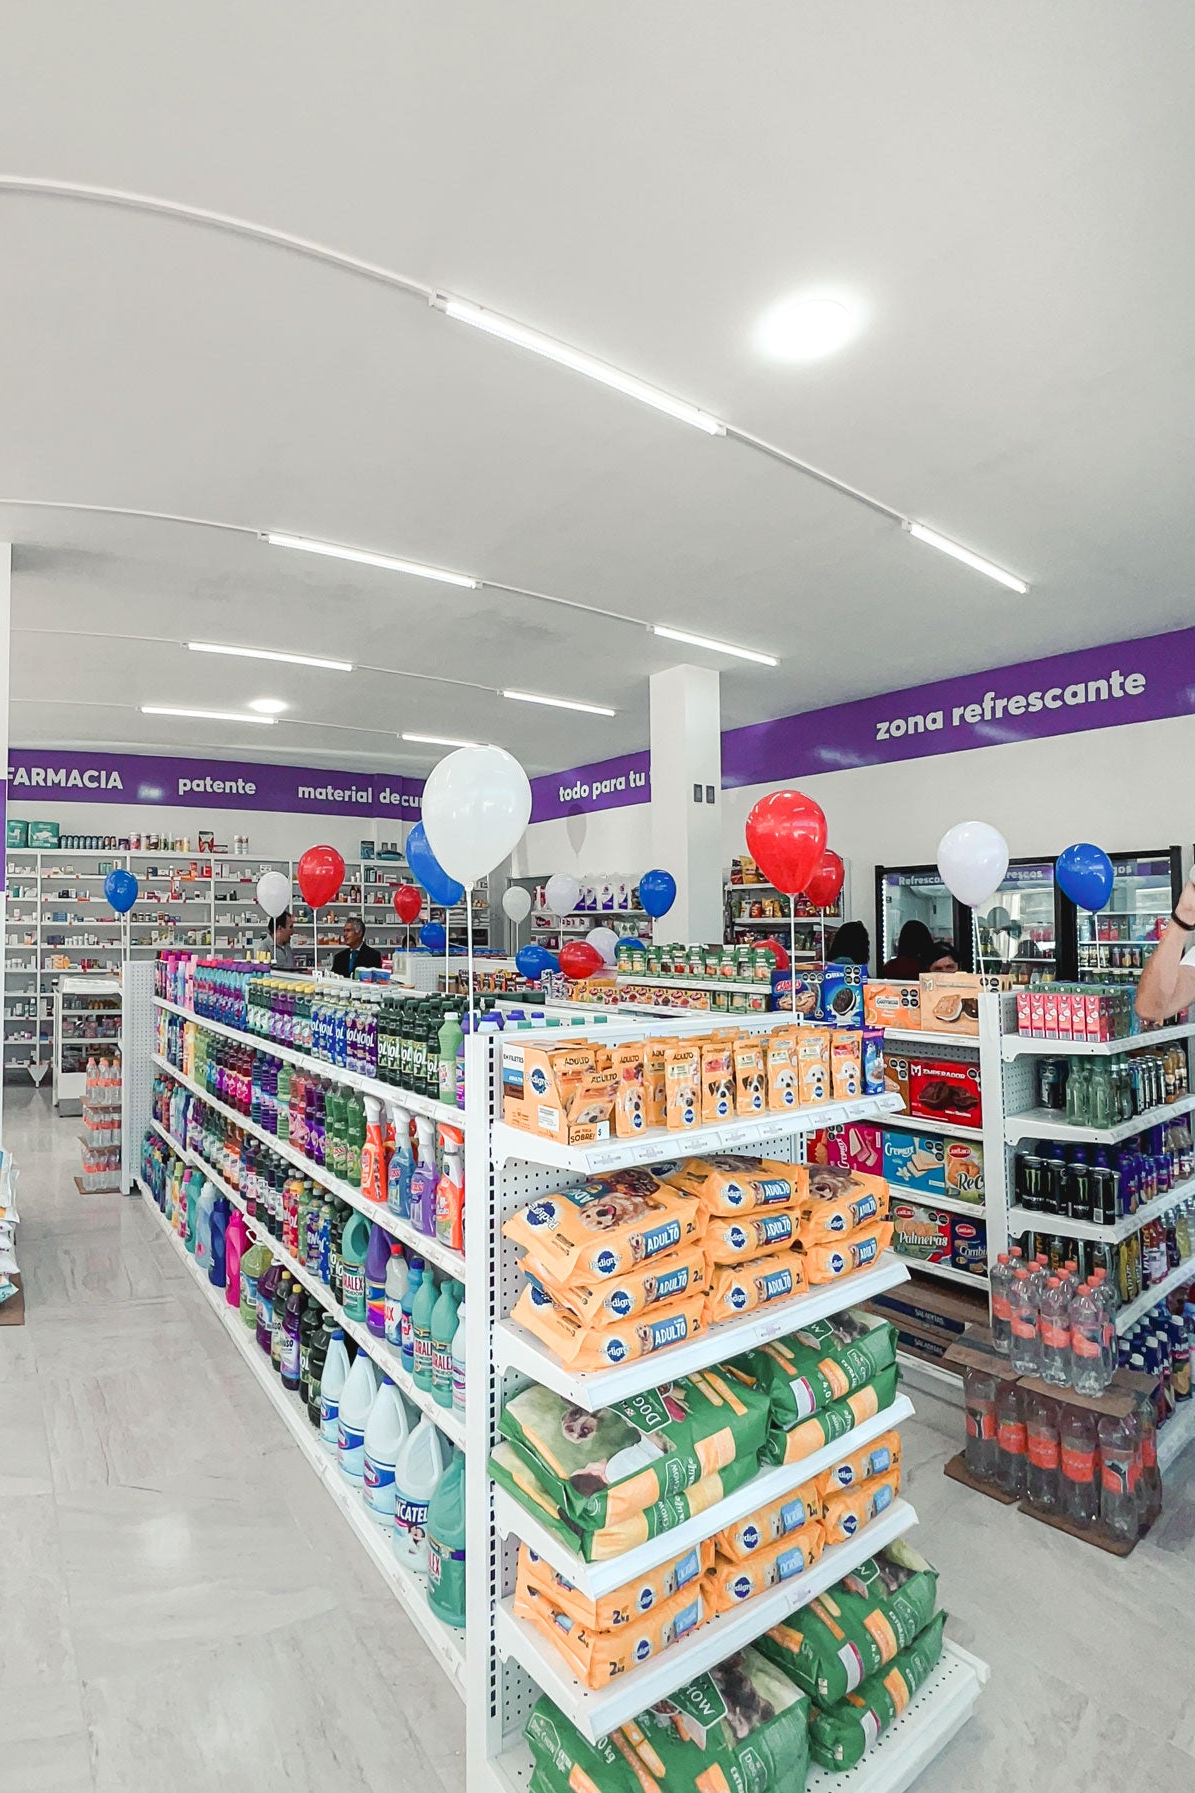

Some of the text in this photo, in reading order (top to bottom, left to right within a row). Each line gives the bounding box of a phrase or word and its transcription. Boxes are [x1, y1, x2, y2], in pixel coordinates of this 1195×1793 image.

[876, 669, 1147, 741] zona refrescante
[178, 776, 256, 796] patente
[298, 785, 373, 804] material
[379, 787, 401, 805] de
[559, 771, 646, 803] todo para tu
[765, 1181, 790, 1196] ADULTO
[647, 1226, 680, 1251] ADULTO
[766, 1218, 792, 1238] ADULTO
[899, 1231, 949, 1246] Palmeras
[342, 1274, 364, 1292] RALEX
[658, 1273, 687, 1294] ADULTO
[767, 1275, 792, 1296] ADULTO
[654, 1322, 687, 1345] ADULTO
[631, 1396, 662, 1427] DOG
[684, 1678, 716, 1717] HOW
